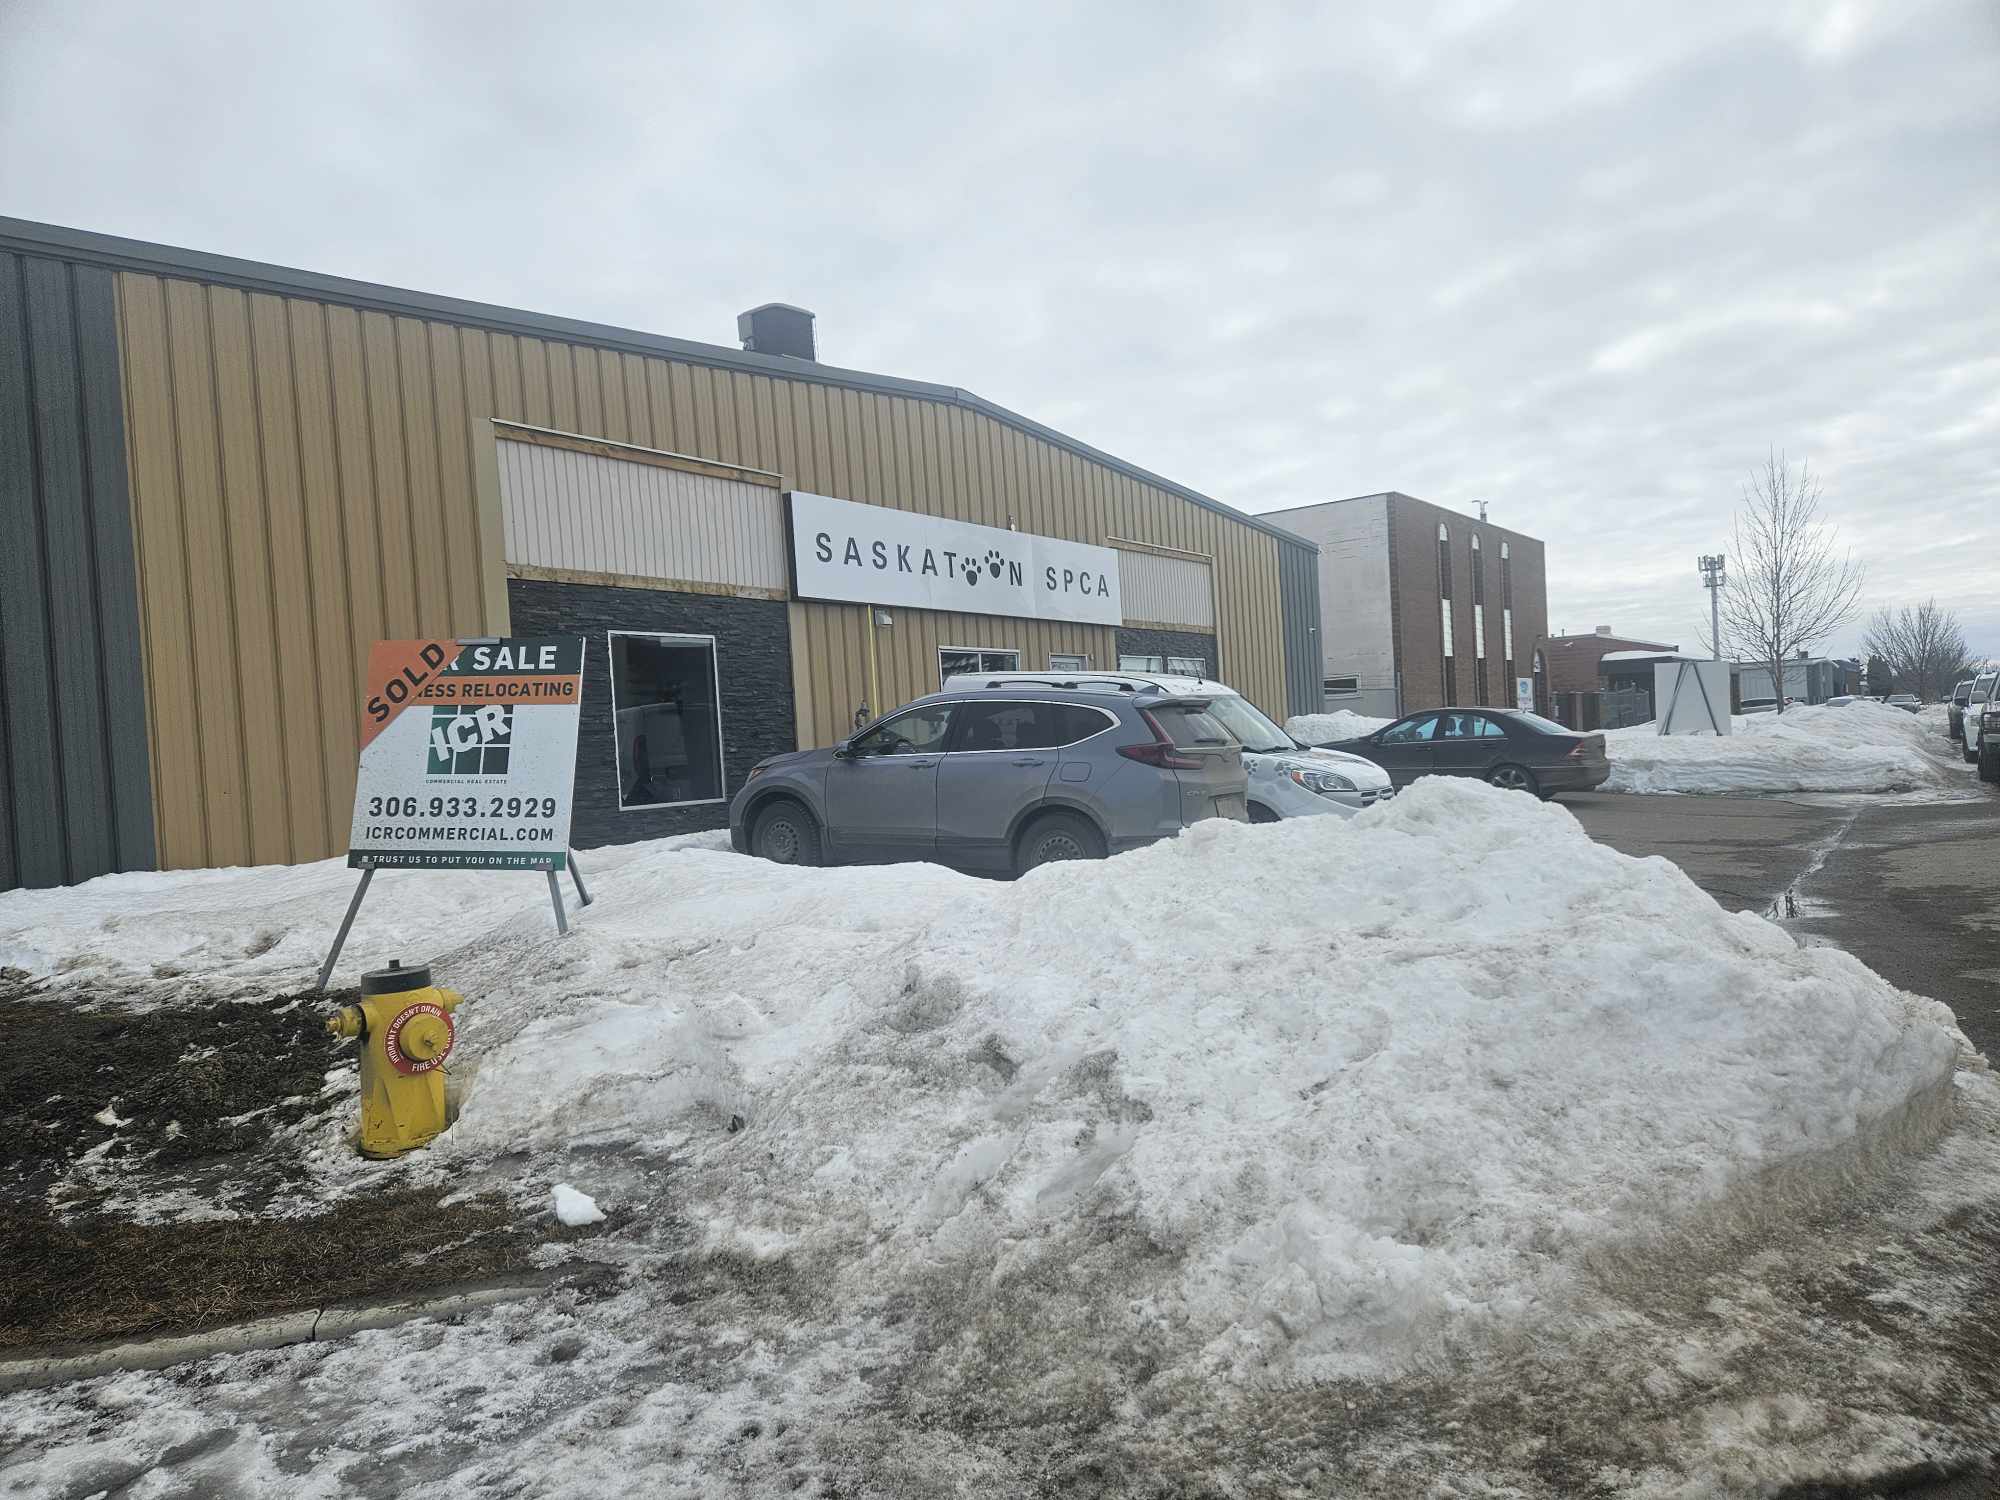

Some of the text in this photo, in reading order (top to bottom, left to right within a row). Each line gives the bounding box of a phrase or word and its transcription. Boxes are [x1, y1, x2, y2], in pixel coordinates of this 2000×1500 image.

[815, 532, 1110, 598] SASKATN SPCA
[472, 646, 558, 671] SALE
[367, 643, 445, 723] SOLD
[462, 682, 574, 697] RELOCATING
[431, 705, 511, 762] ICR
[368, 796, 556, 819] 306.933.2929
[366, 826, 554, 842] ICRCOMMERCIAL.COM
[372, 855, 552, 865] TRUST US TO PUT YOU ON THE MAP
[386, 1005, 442, 1064] HYDRANT DOESN'T DRAIN
[411, 1060, 431, 1072] FIRE
